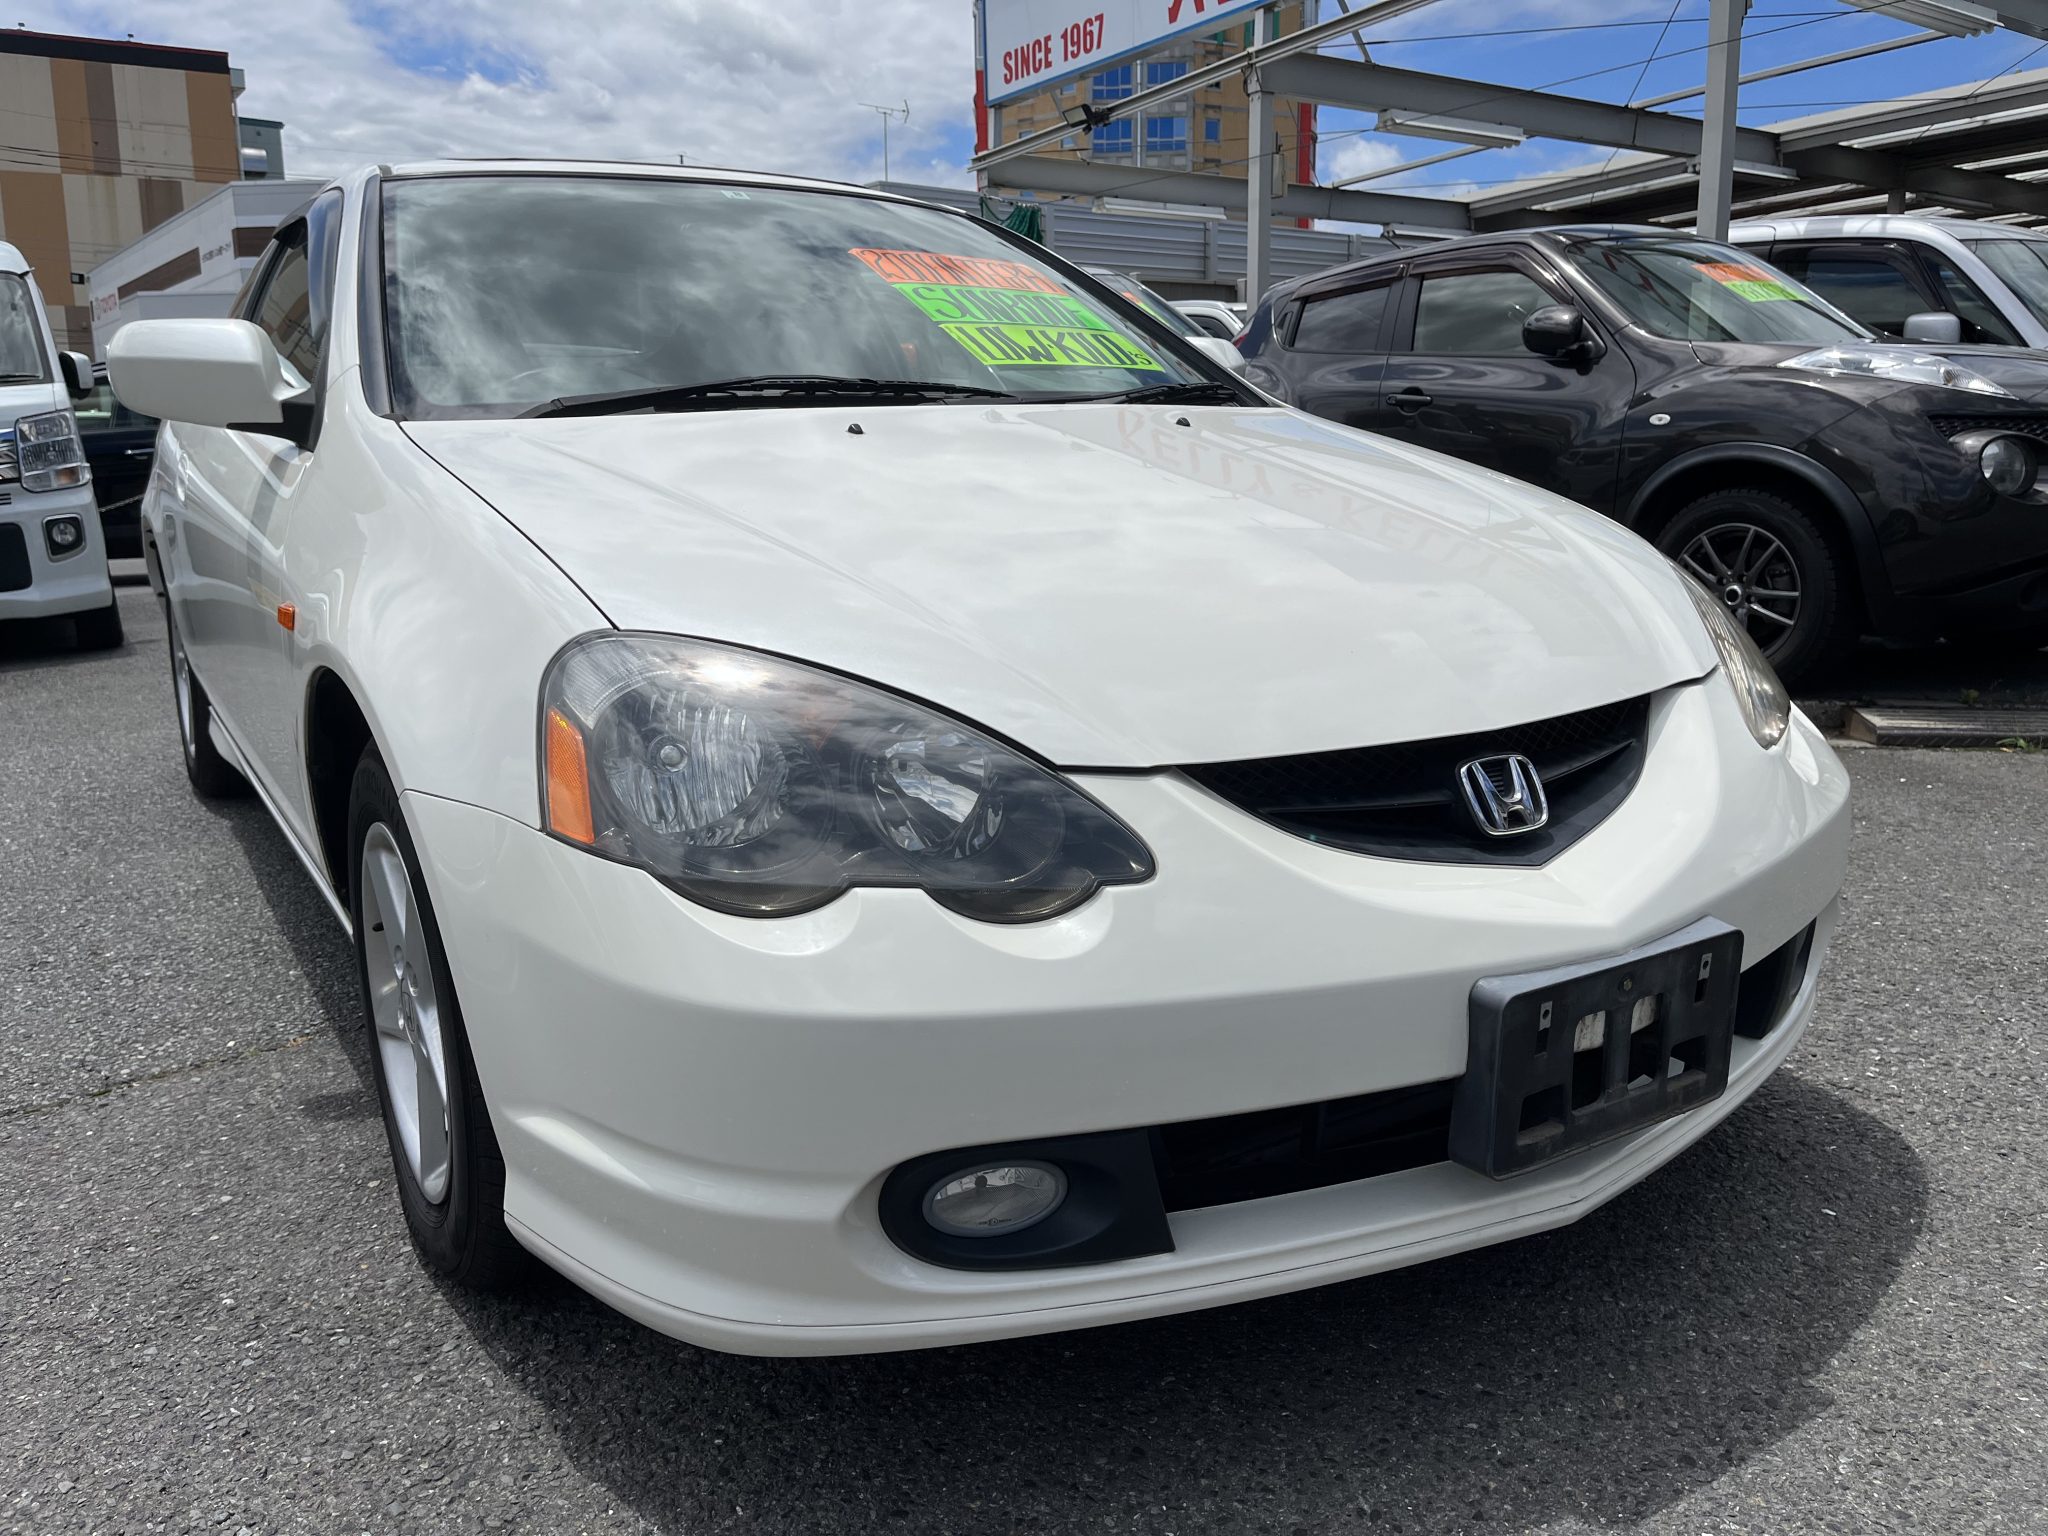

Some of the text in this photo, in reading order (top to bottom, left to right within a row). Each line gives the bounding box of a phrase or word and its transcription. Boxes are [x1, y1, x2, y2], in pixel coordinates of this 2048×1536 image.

[1003, 13, 1105, 85] SINCE 1967
[911, 286, 1088, 327] SUNROOF
